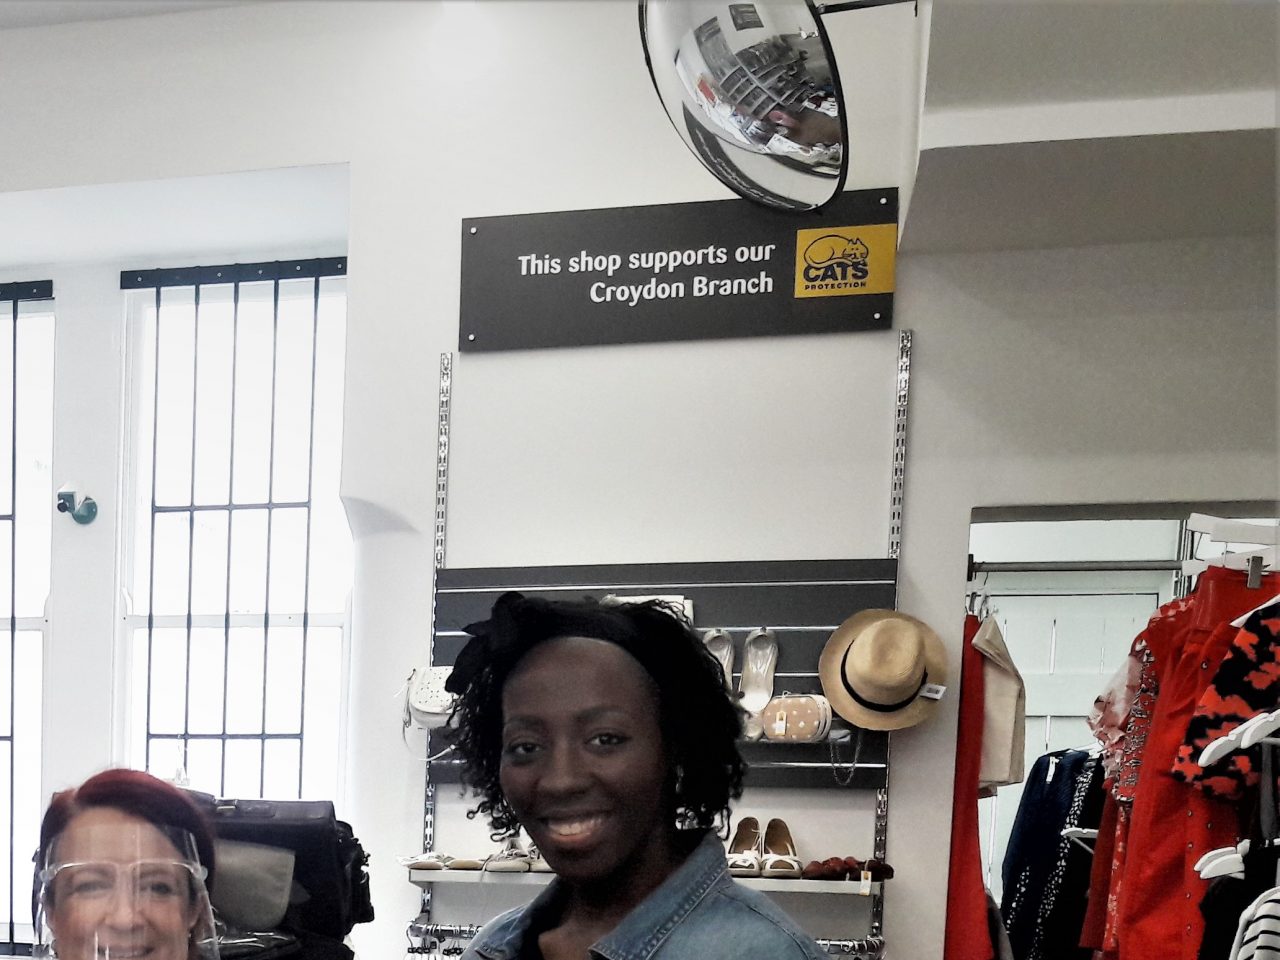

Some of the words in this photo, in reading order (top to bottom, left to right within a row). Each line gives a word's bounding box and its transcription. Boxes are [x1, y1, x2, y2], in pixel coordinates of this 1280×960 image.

[517, 254, 562, 275] This
[567, 249, 622, 277] shop
[627, 245, 728, 274] supports
[734, 243, 776, 263] our
[802, 261, 869, 283] CATS
[589, 277, 685, 307] Croydon
[692, 275, 774, 297] Branch
[804, 280, 868, 292] PROTECTION
